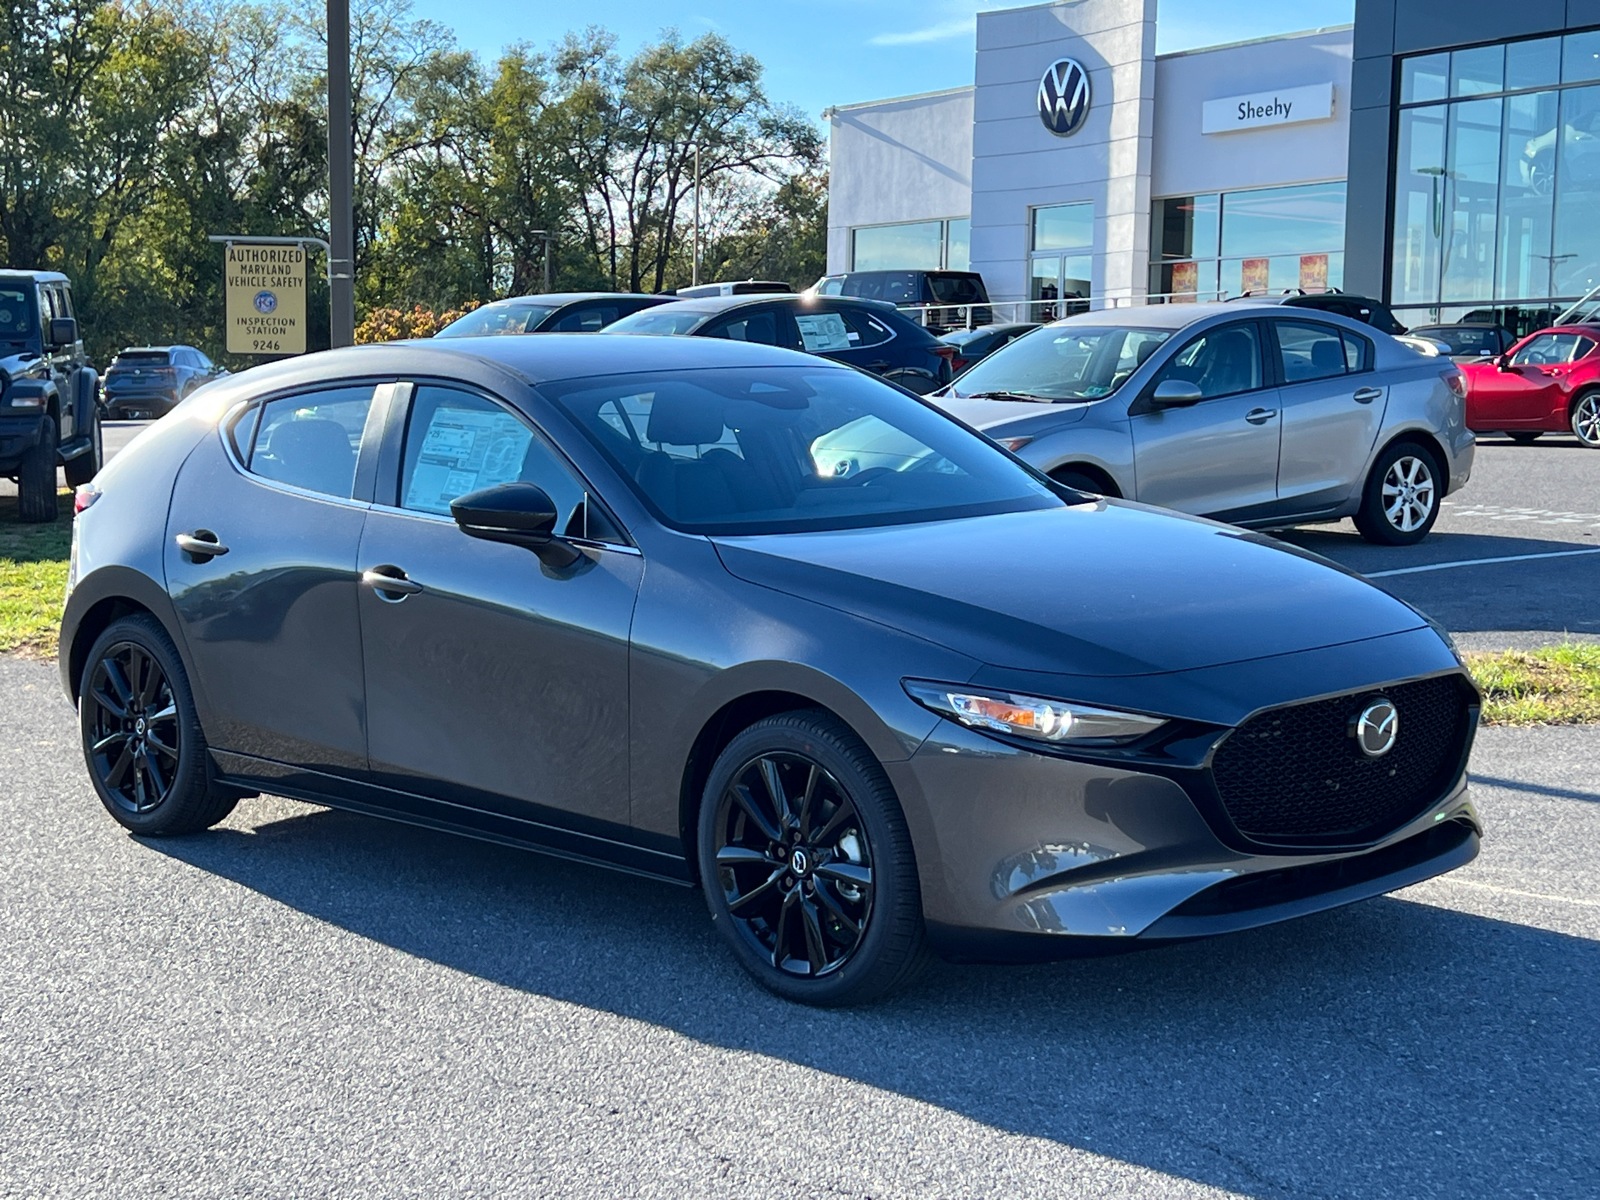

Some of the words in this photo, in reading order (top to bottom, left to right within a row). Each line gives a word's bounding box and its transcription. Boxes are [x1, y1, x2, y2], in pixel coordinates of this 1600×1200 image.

[1038, 58, 1090, 137] VW
[1238, 97, 1292, 120] Sheehy
[229, 250, 302, 262] AUTHORIZED
[240, 264, 291, 275] MARYLAND
[229, 276, 266, 287] VEHICLE
[271, 277, 303, 287] SAFETY
[237, 318, 295, 326] INSPECTION
[246, 327, 286, 335] STATION
[253, 340, 280, 350] 9246
